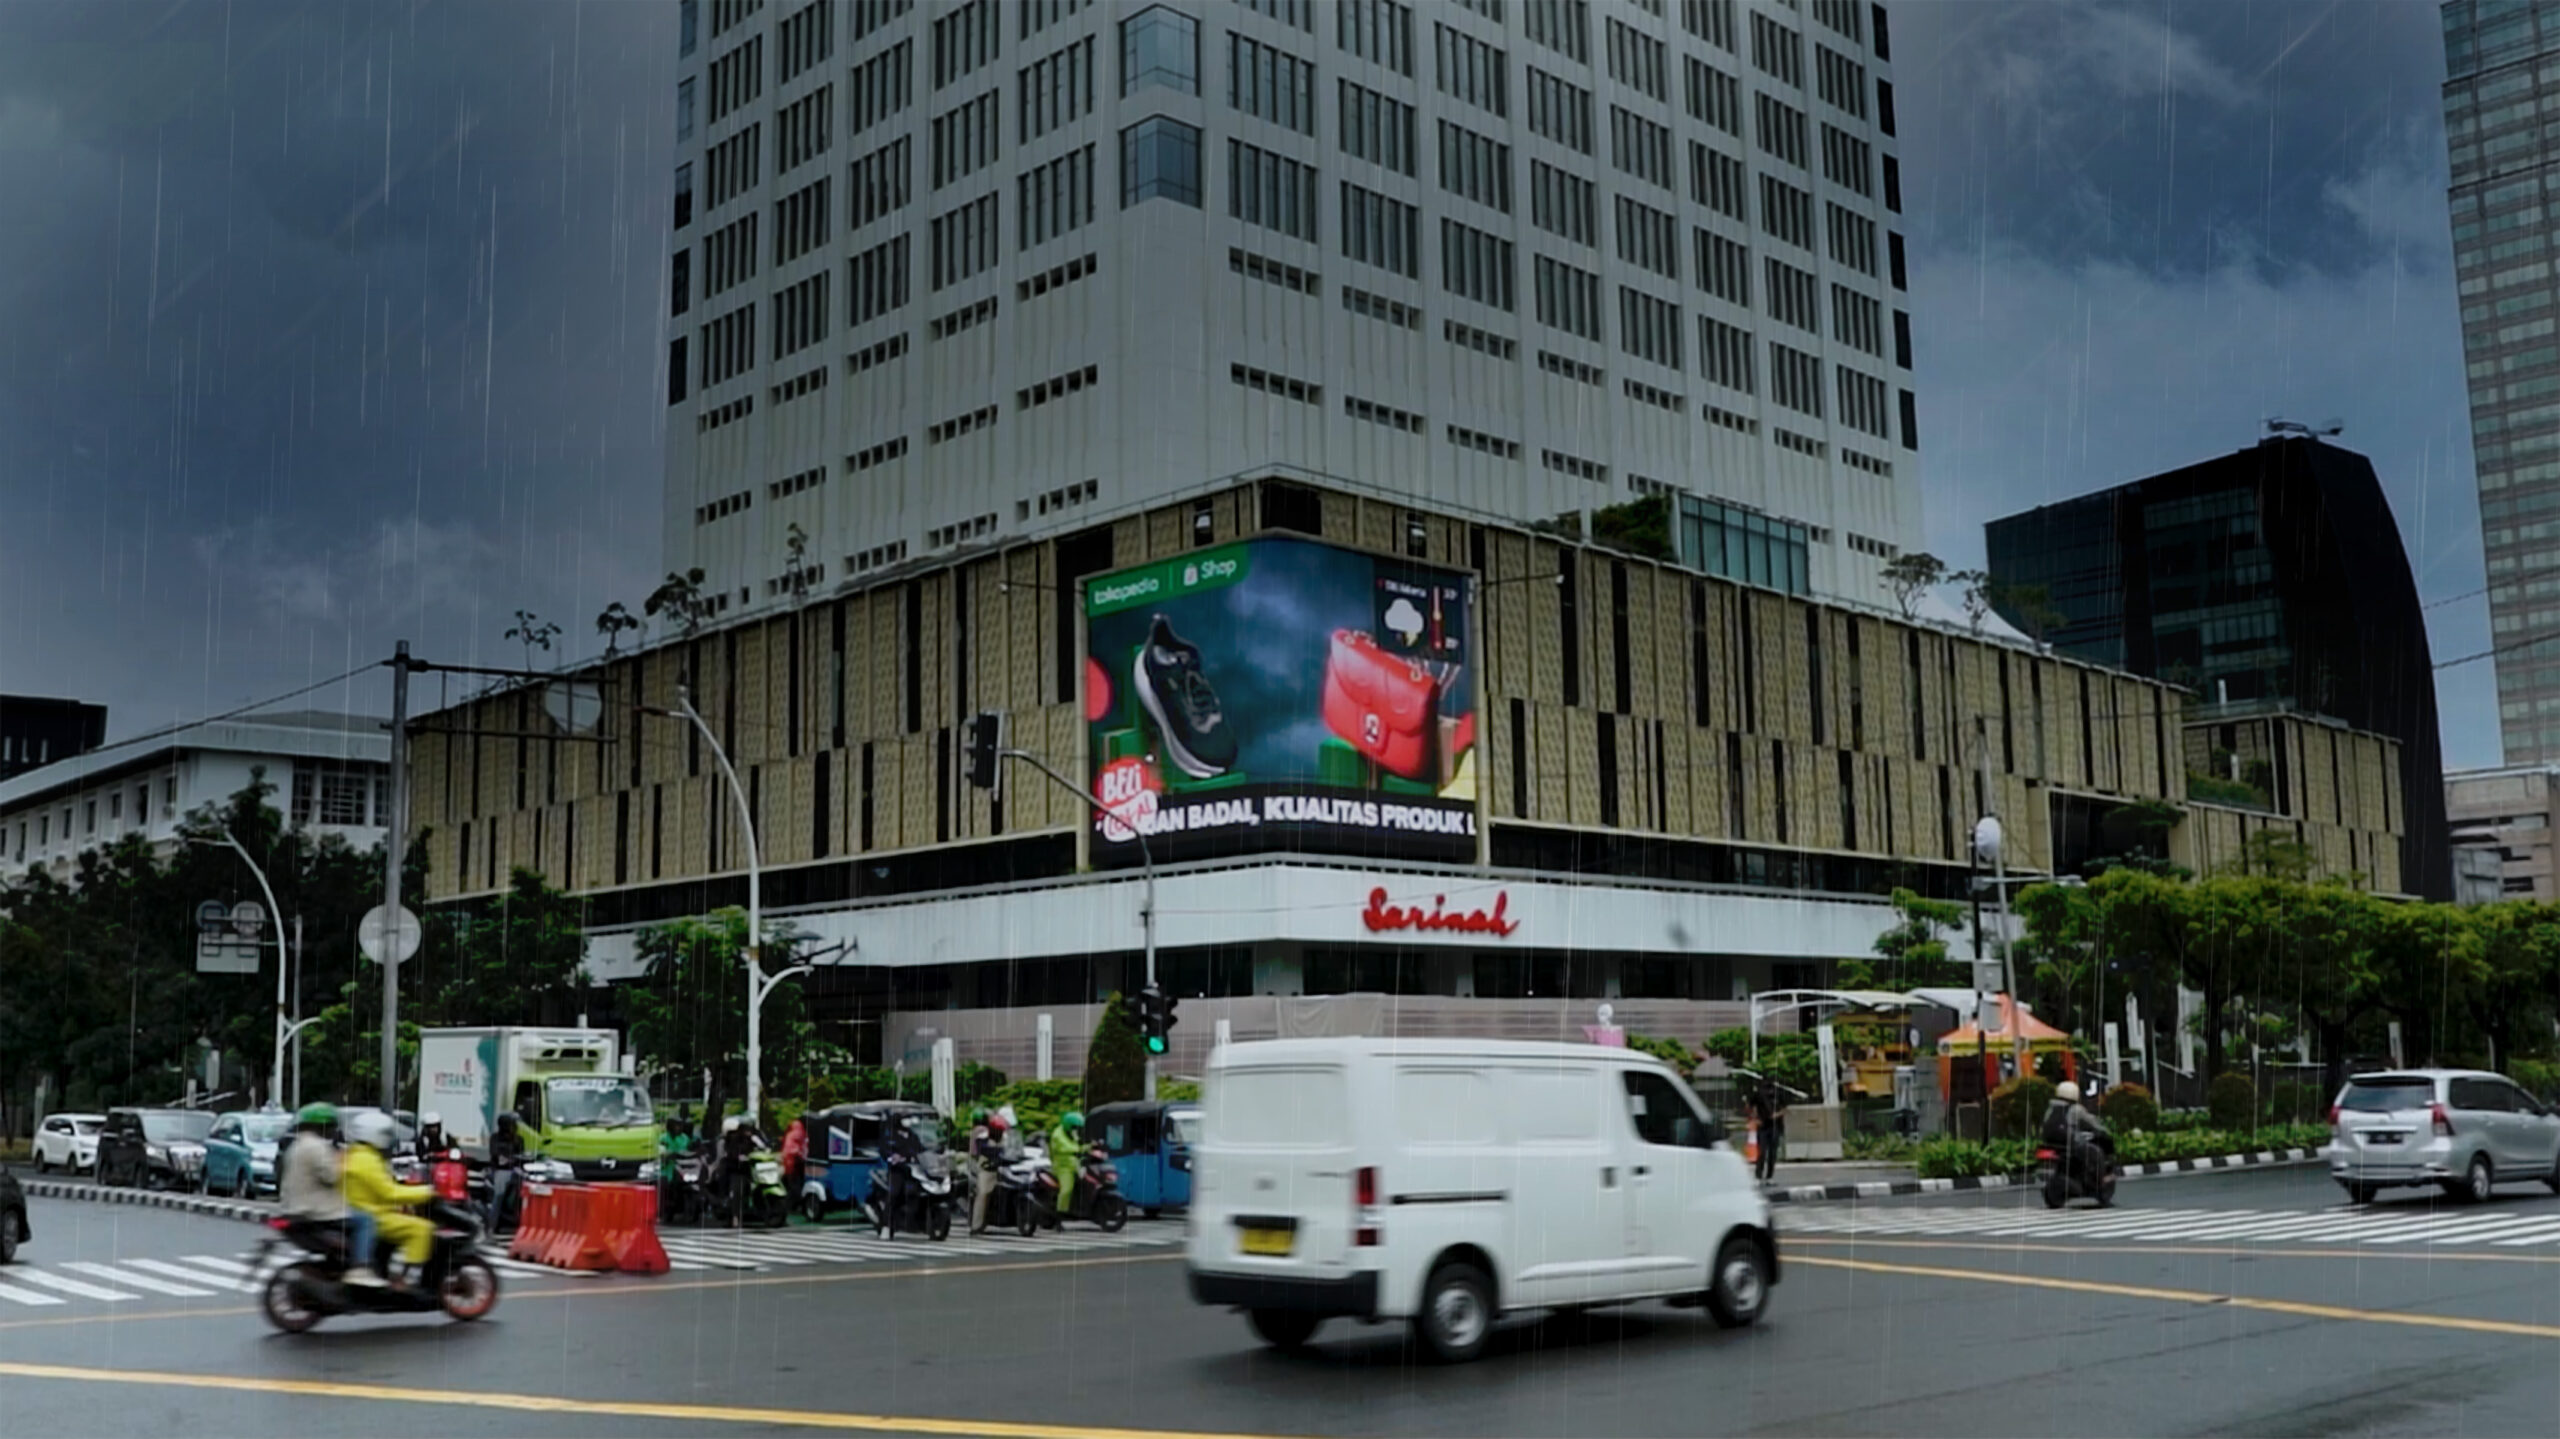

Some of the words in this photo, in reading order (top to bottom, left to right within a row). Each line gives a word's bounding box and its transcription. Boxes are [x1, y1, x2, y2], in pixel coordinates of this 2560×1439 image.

[1094, 579, 1159, 604] tokopedia
[1201, 560, 1237, 579] Shop
[1264, 796, 1380, 827] KUALITAS
[1381, 804, 1465, 835] PRODUK
[1362, 886, 1521, 938] Sarinah
